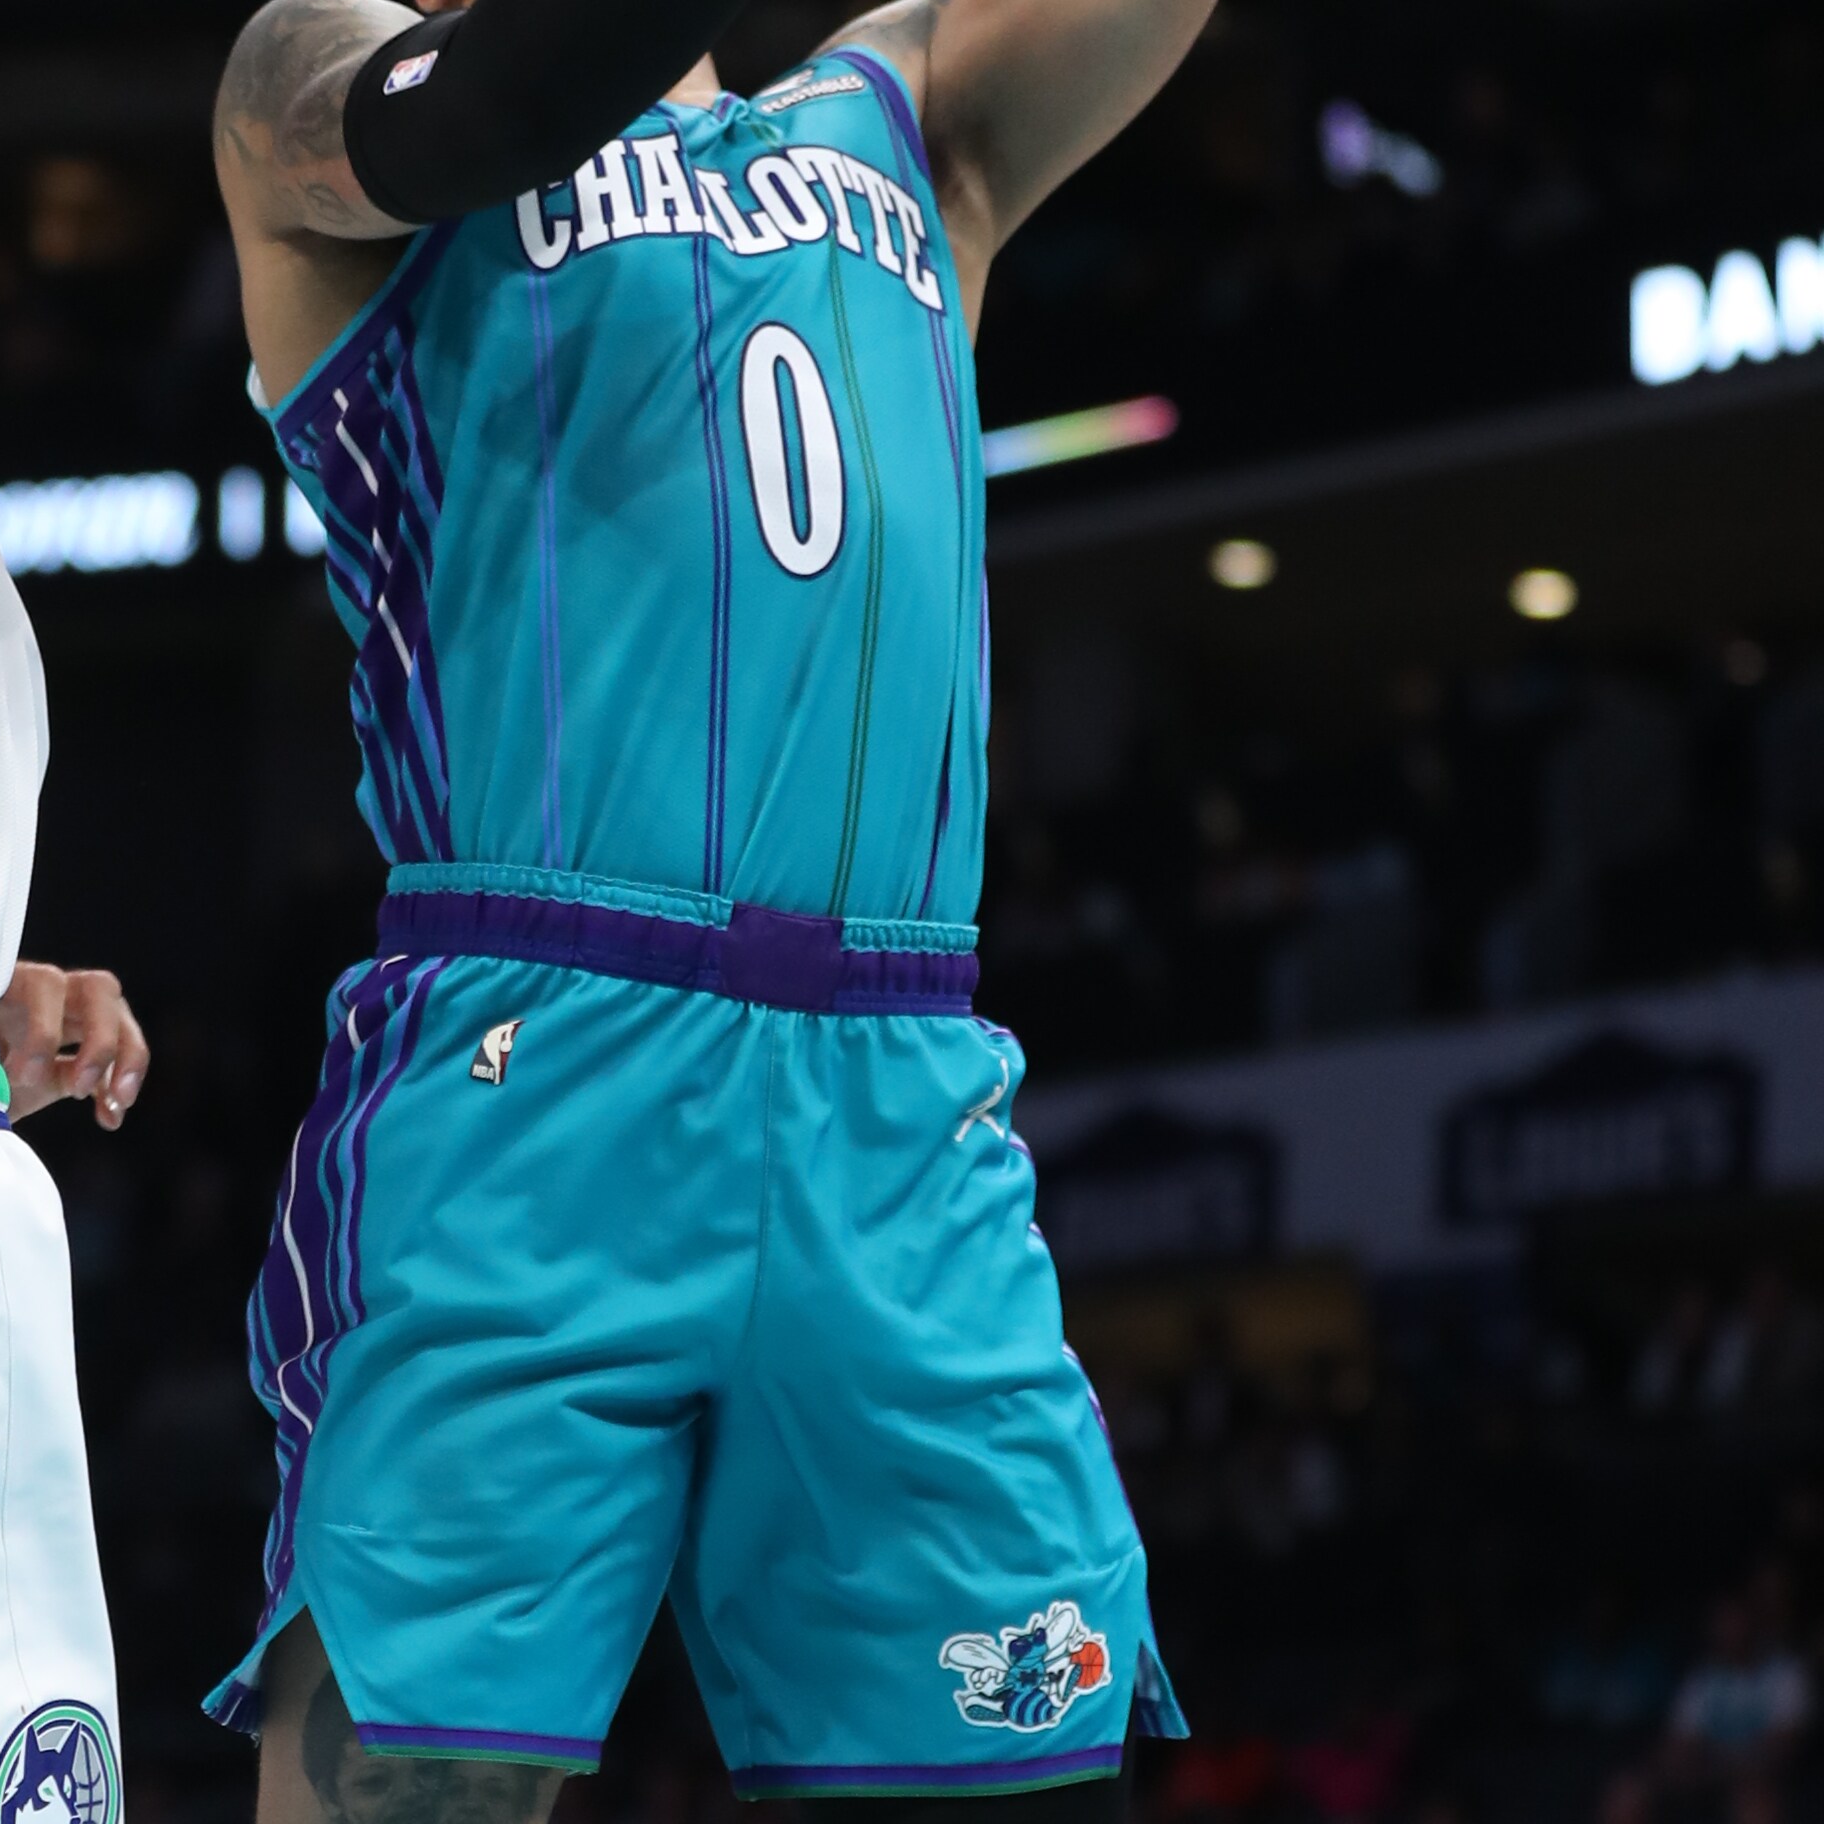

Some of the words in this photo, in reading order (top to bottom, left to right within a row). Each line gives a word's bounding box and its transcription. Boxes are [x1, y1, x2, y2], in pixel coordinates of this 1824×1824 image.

[513, 132, 946, 312] CHALOTTE
[740, 321, 847, 581] 0
[472, 1063, 495, 1081] NBA
